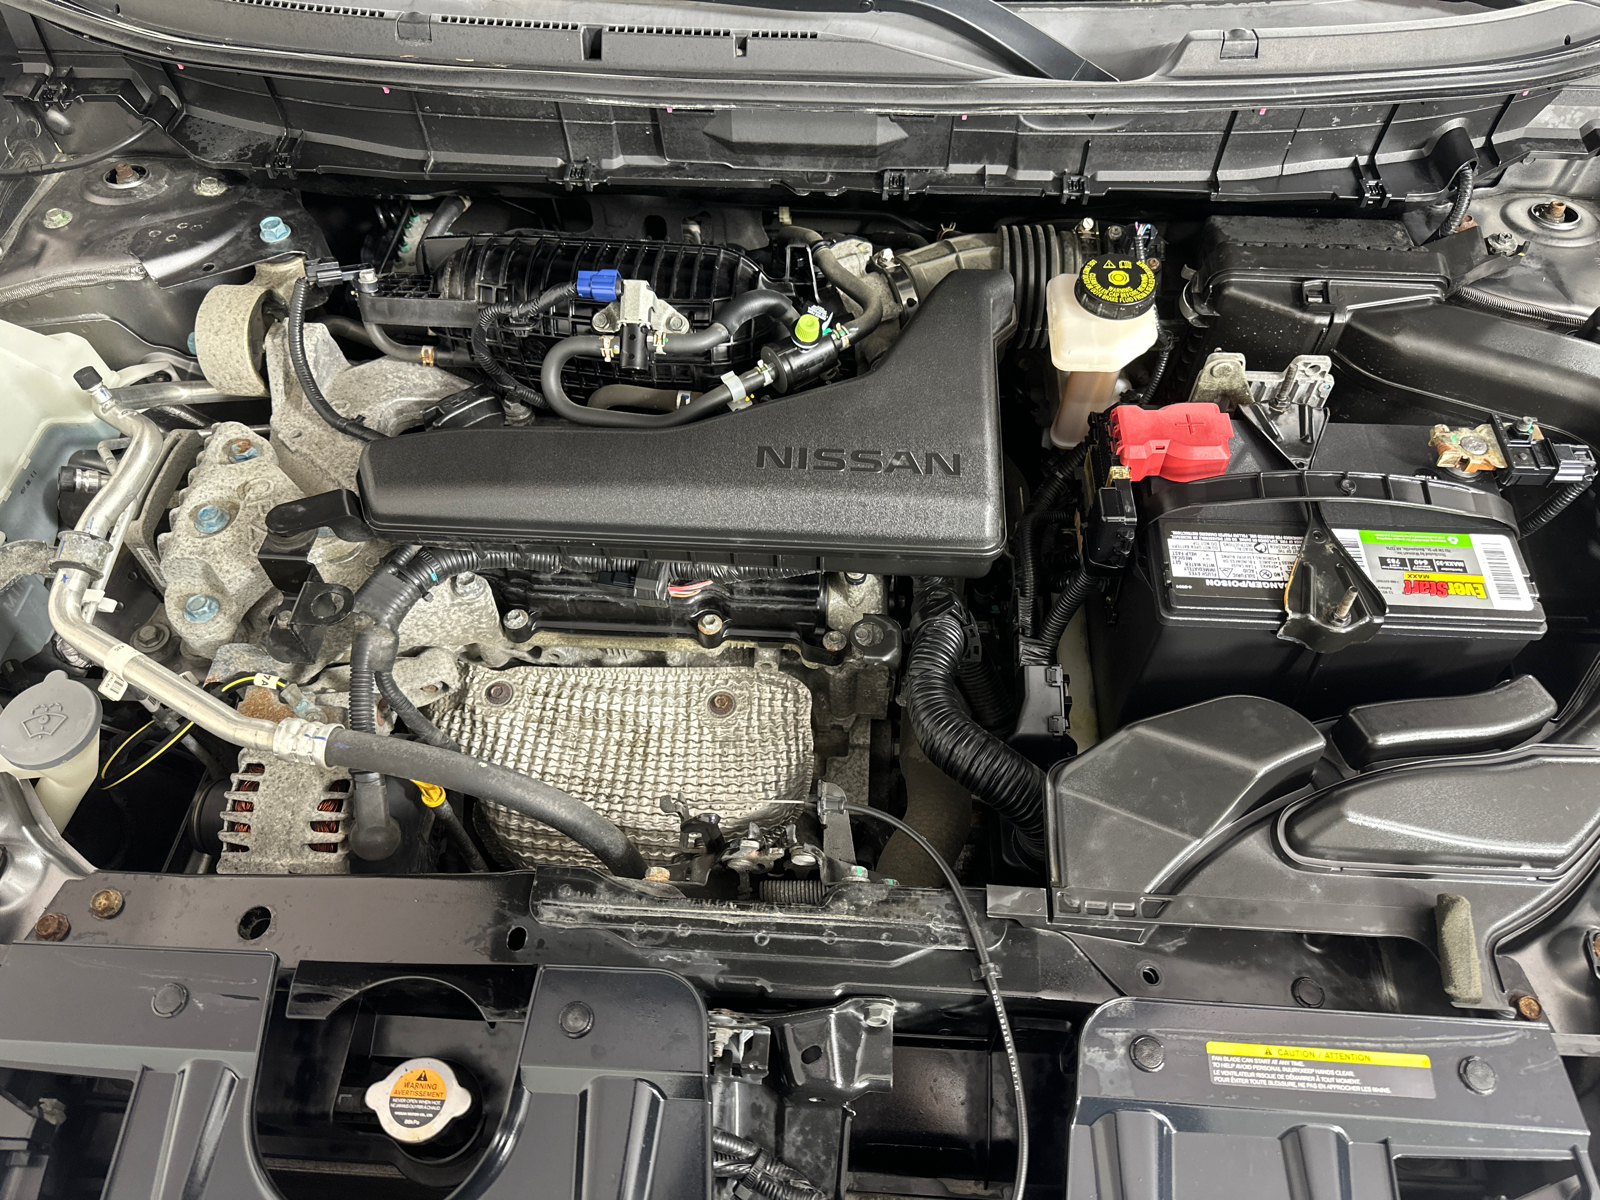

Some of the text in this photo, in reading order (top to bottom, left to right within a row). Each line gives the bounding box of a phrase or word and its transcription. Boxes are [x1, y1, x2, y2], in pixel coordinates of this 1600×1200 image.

[756, 445, 962, 477] NISSAN
[1403, 579, 1488, 599] EverStart
[1277, 1048, 1315, 1058] CAUTION
[1325, 1052, 1371, 1062] ATTENTION
[1220, 1070, 1255, 1078] VENTILATEUR
[404, 1082, 438, 1090] WARNING
[1326, 1084, 1360, 1092] APPROCHER
[394, 1089, 444, 1098] AVERTISSEMENT
